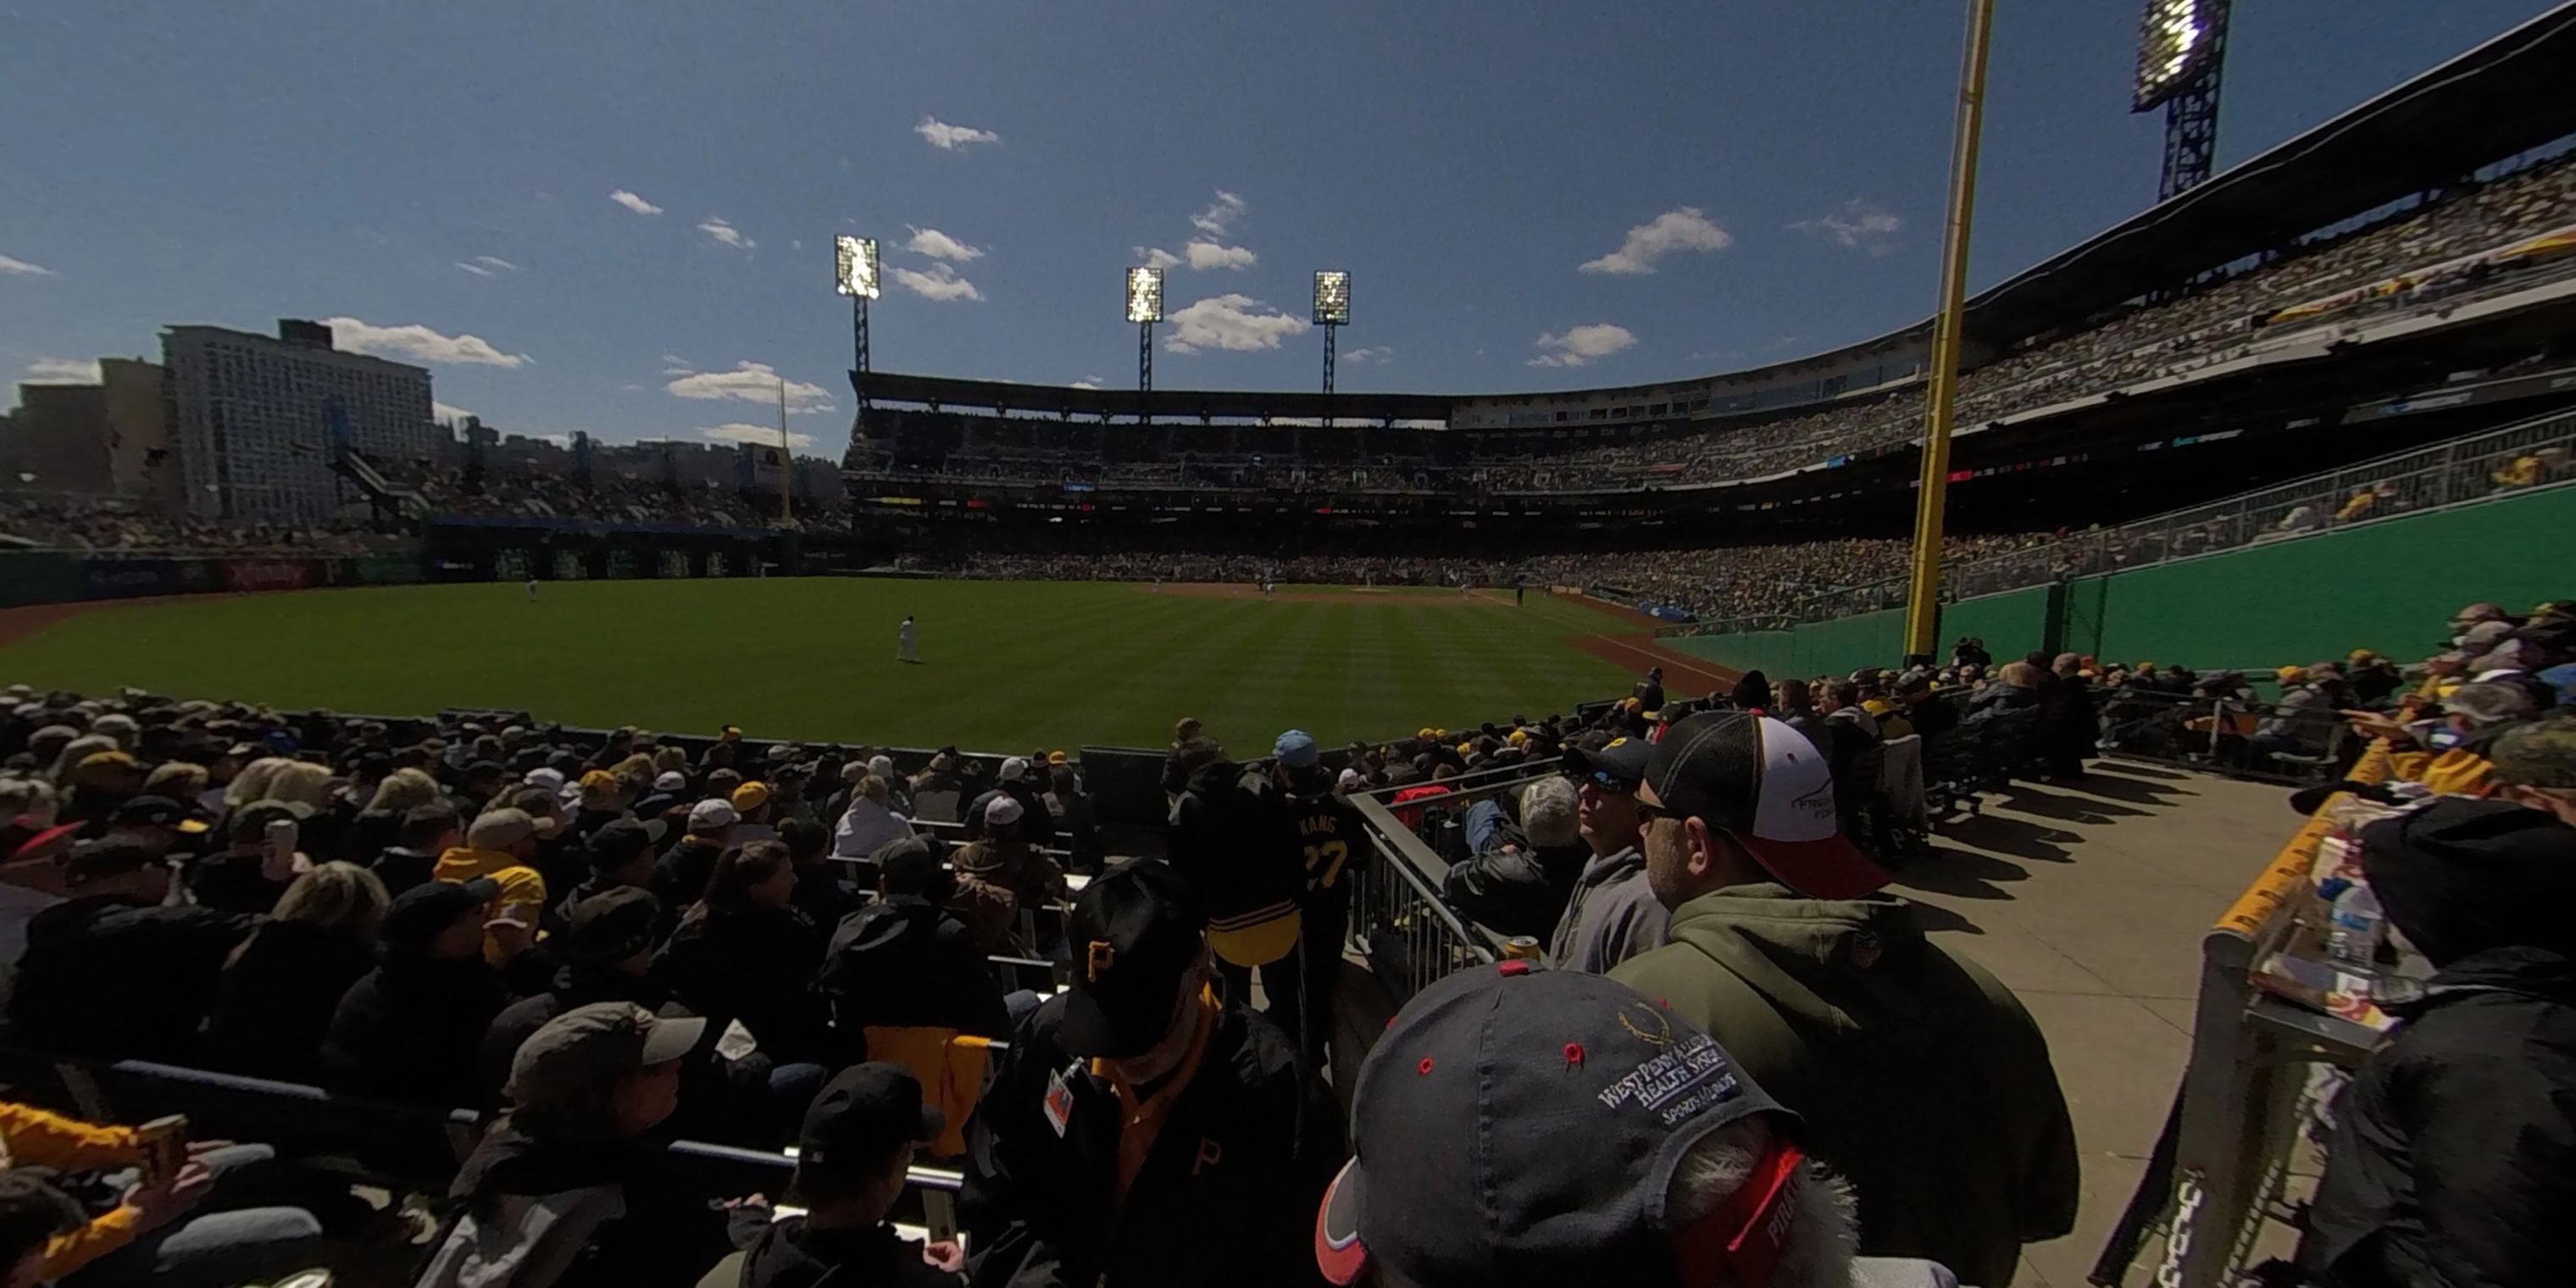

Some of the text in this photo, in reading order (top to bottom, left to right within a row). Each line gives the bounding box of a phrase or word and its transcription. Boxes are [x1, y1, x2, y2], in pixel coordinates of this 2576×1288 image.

[1298, 814, 1337, 836] KANG
[1304, 840, 1348, 892] 27
[1088, 940, 1116, 984] P
[1597, 1069, 1643, 1109] WEST
[1637, 1051, 1679, 1082] PENNY
[1634, 1064, 1692, 1108] HEALTH
[1661, 1096, 1702, 1126] SPORTS
[1192, 1135, 1222, 1176] P
